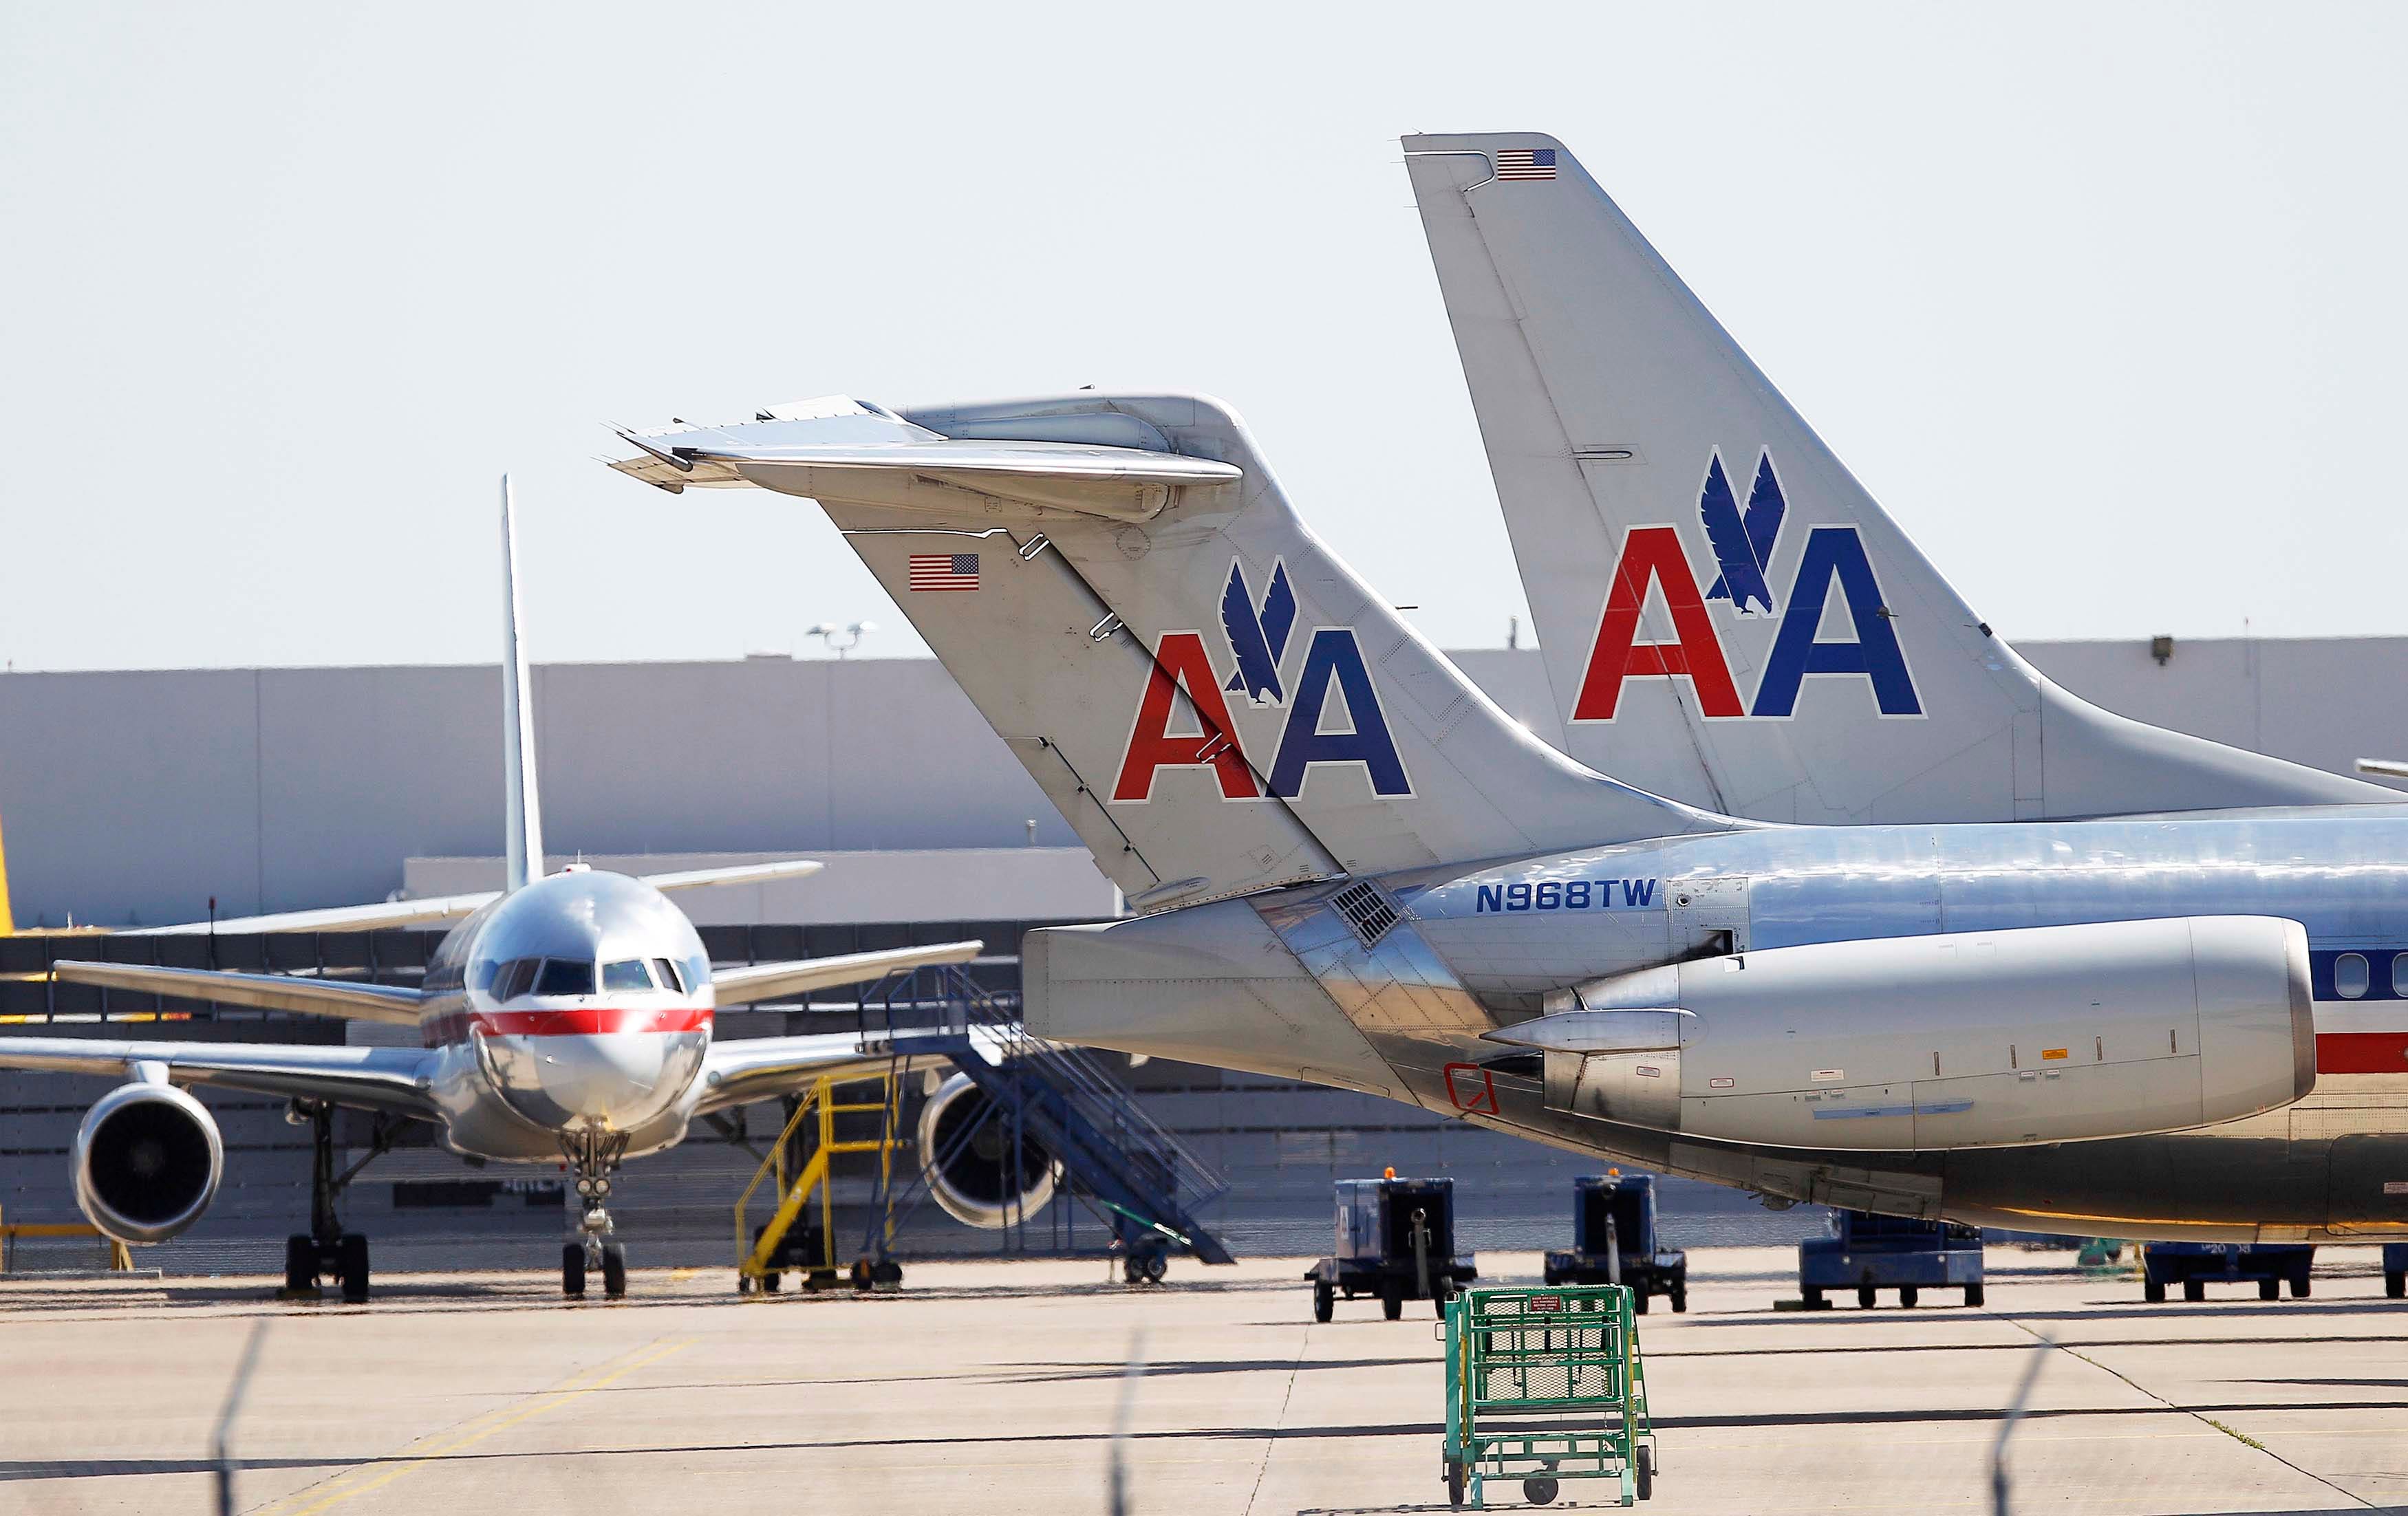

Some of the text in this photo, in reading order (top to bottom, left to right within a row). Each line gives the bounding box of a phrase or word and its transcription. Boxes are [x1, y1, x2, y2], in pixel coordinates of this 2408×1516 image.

[1568, 523, 1928, 724] AA
[1107, 626, 1417, 805] AA
[1476, 879, 1656, 913] N968TW
